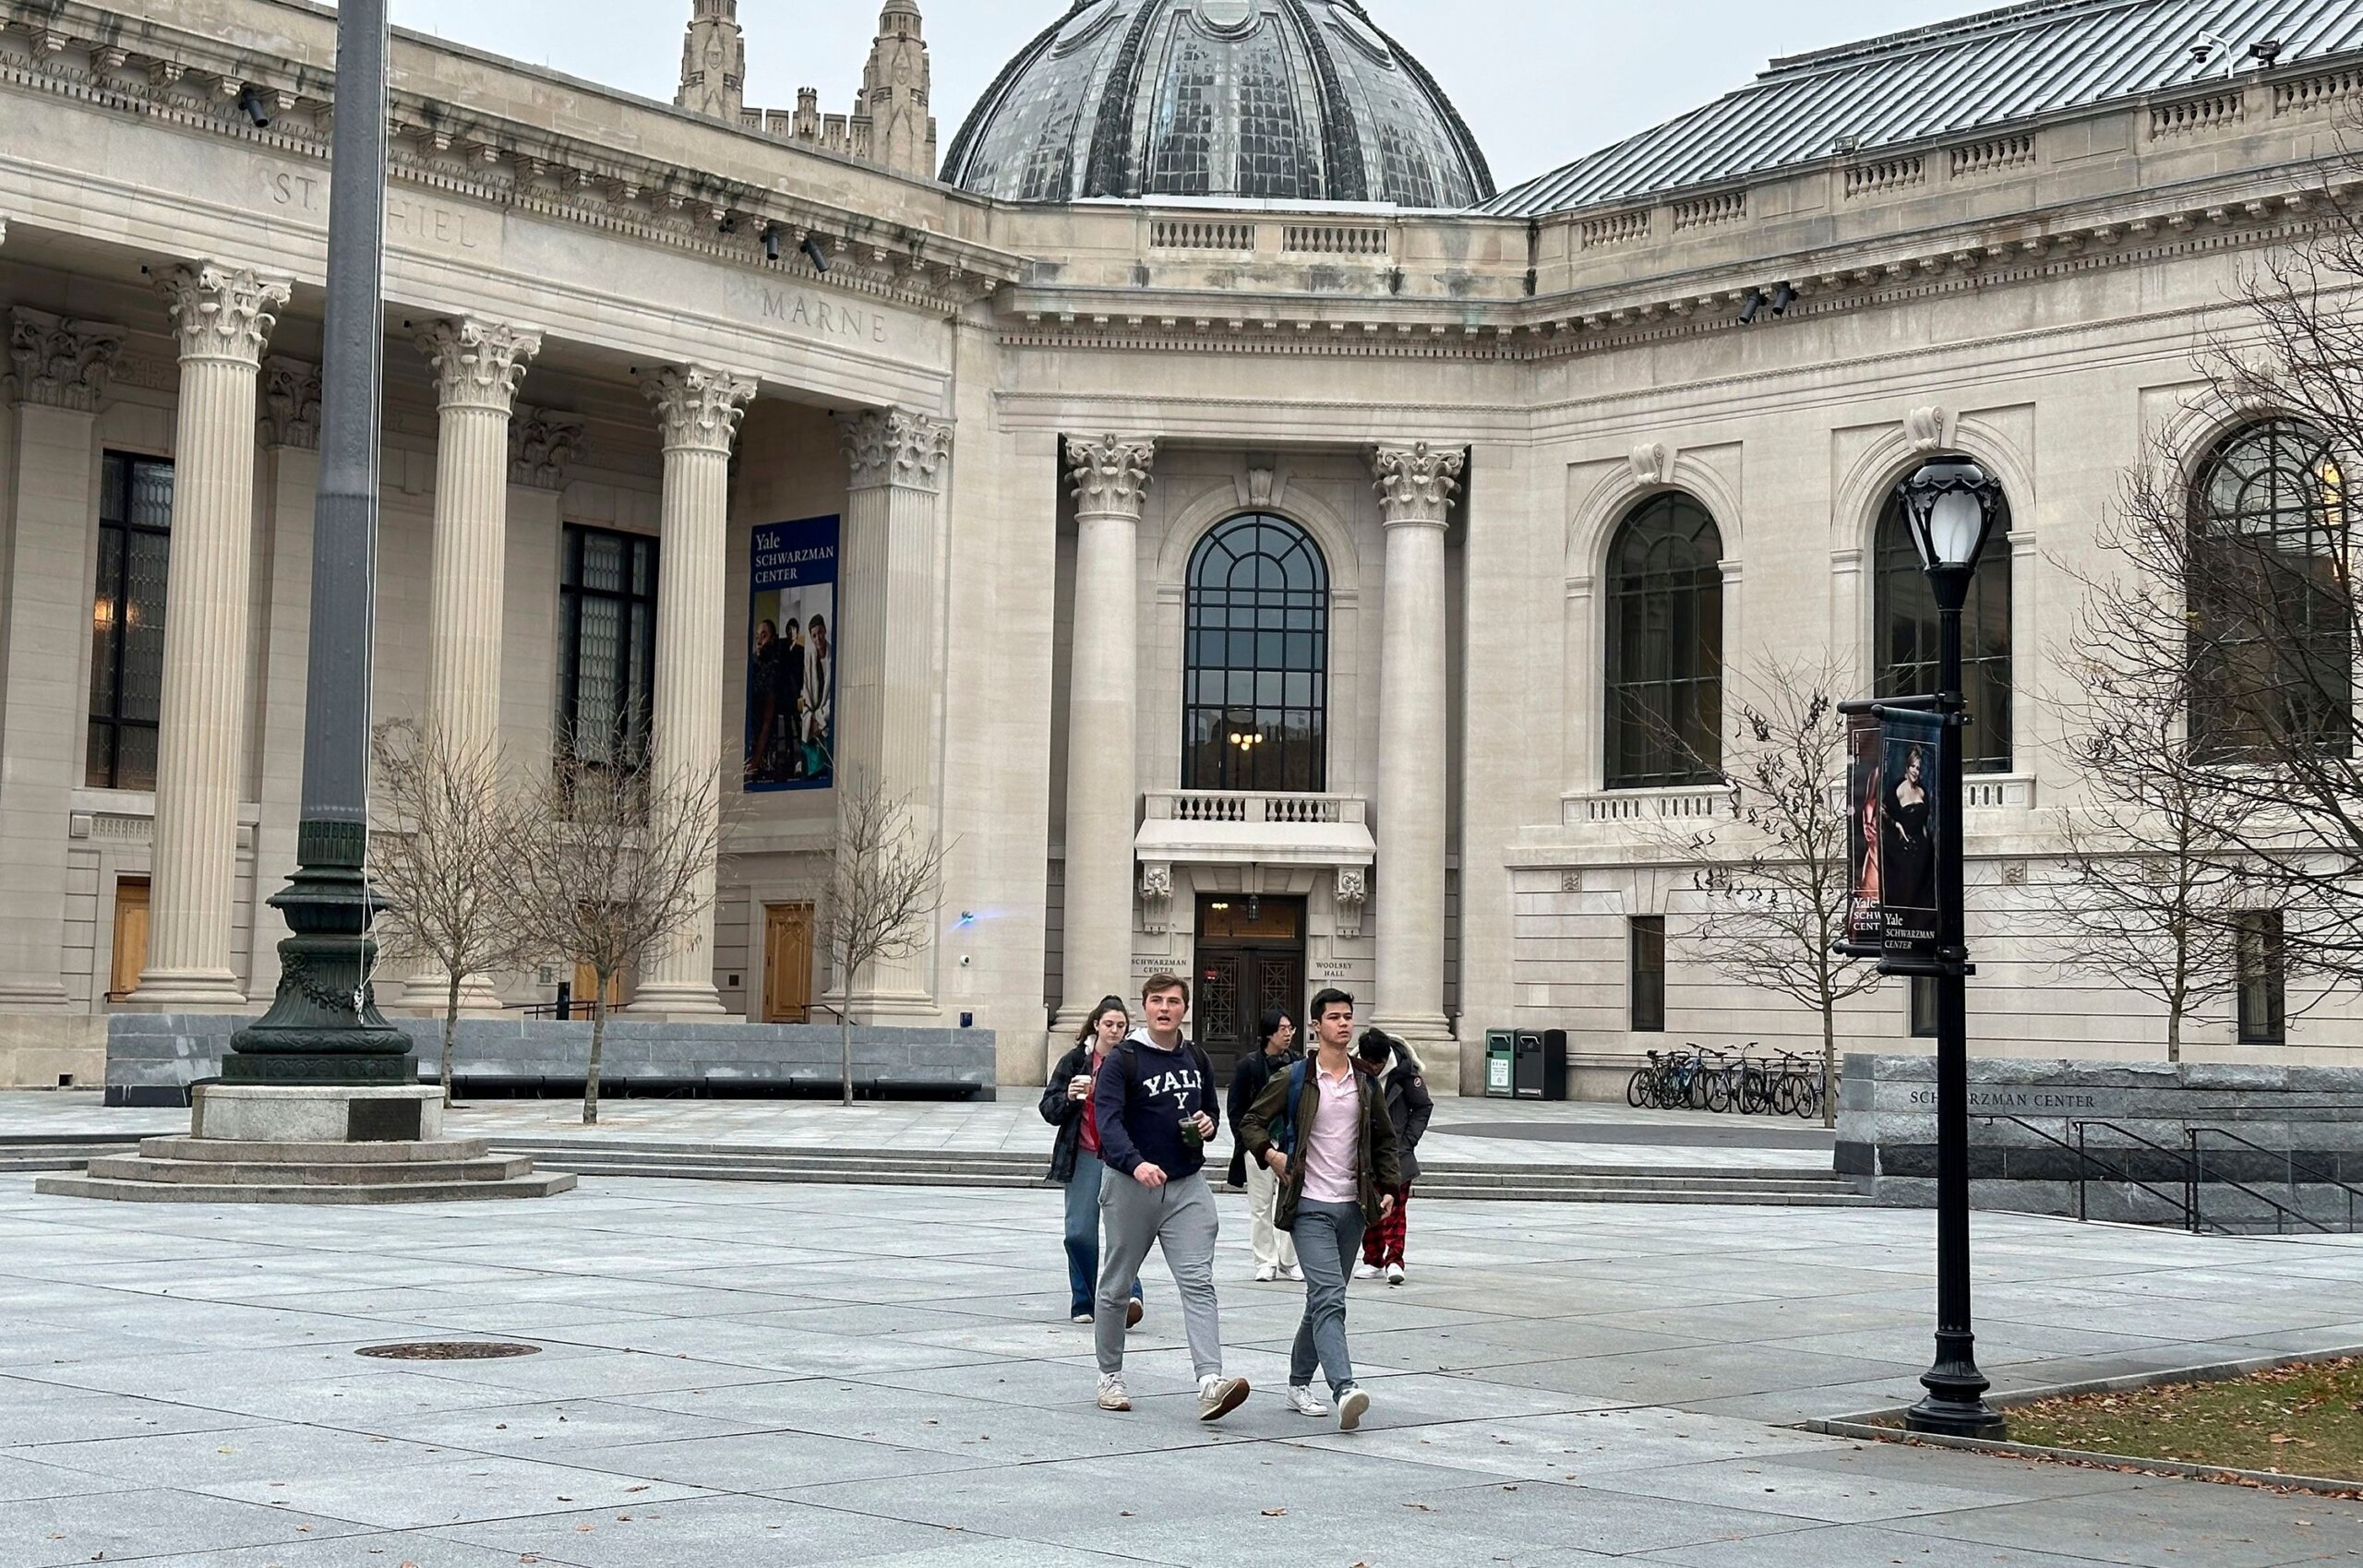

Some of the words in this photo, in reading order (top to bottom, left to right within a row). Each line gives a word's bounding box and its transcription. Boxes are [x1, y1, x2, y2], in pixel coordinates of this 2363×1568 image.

[272, 173, 318, 211] ST.
[386, 197, 476, 248] HIEL
[762, 288, 887, 342] MARNE
[755, 532, 781, 551] Yale
[755, 545, 834, 568] SCHWARZMAN
[755, 568, 798, 583] CENTER
[1853, 897, 1877, 909] Yale
[1853, 922, 1880, 931] CENT
[1884, 913, 1903, 926] Yale
[1886, 928, 1936, 940] SCHWARZMAN
[1884, 940, 1913, 950] CENTER
[1131, 958, 1187, 966] SCHWARZMAN
[1173, 1091, 1190, 1109] Y
[1909, 1091, 2027, 1107] SCHRZMAN
[2033, 1094, 2094, 1107] CENTER
